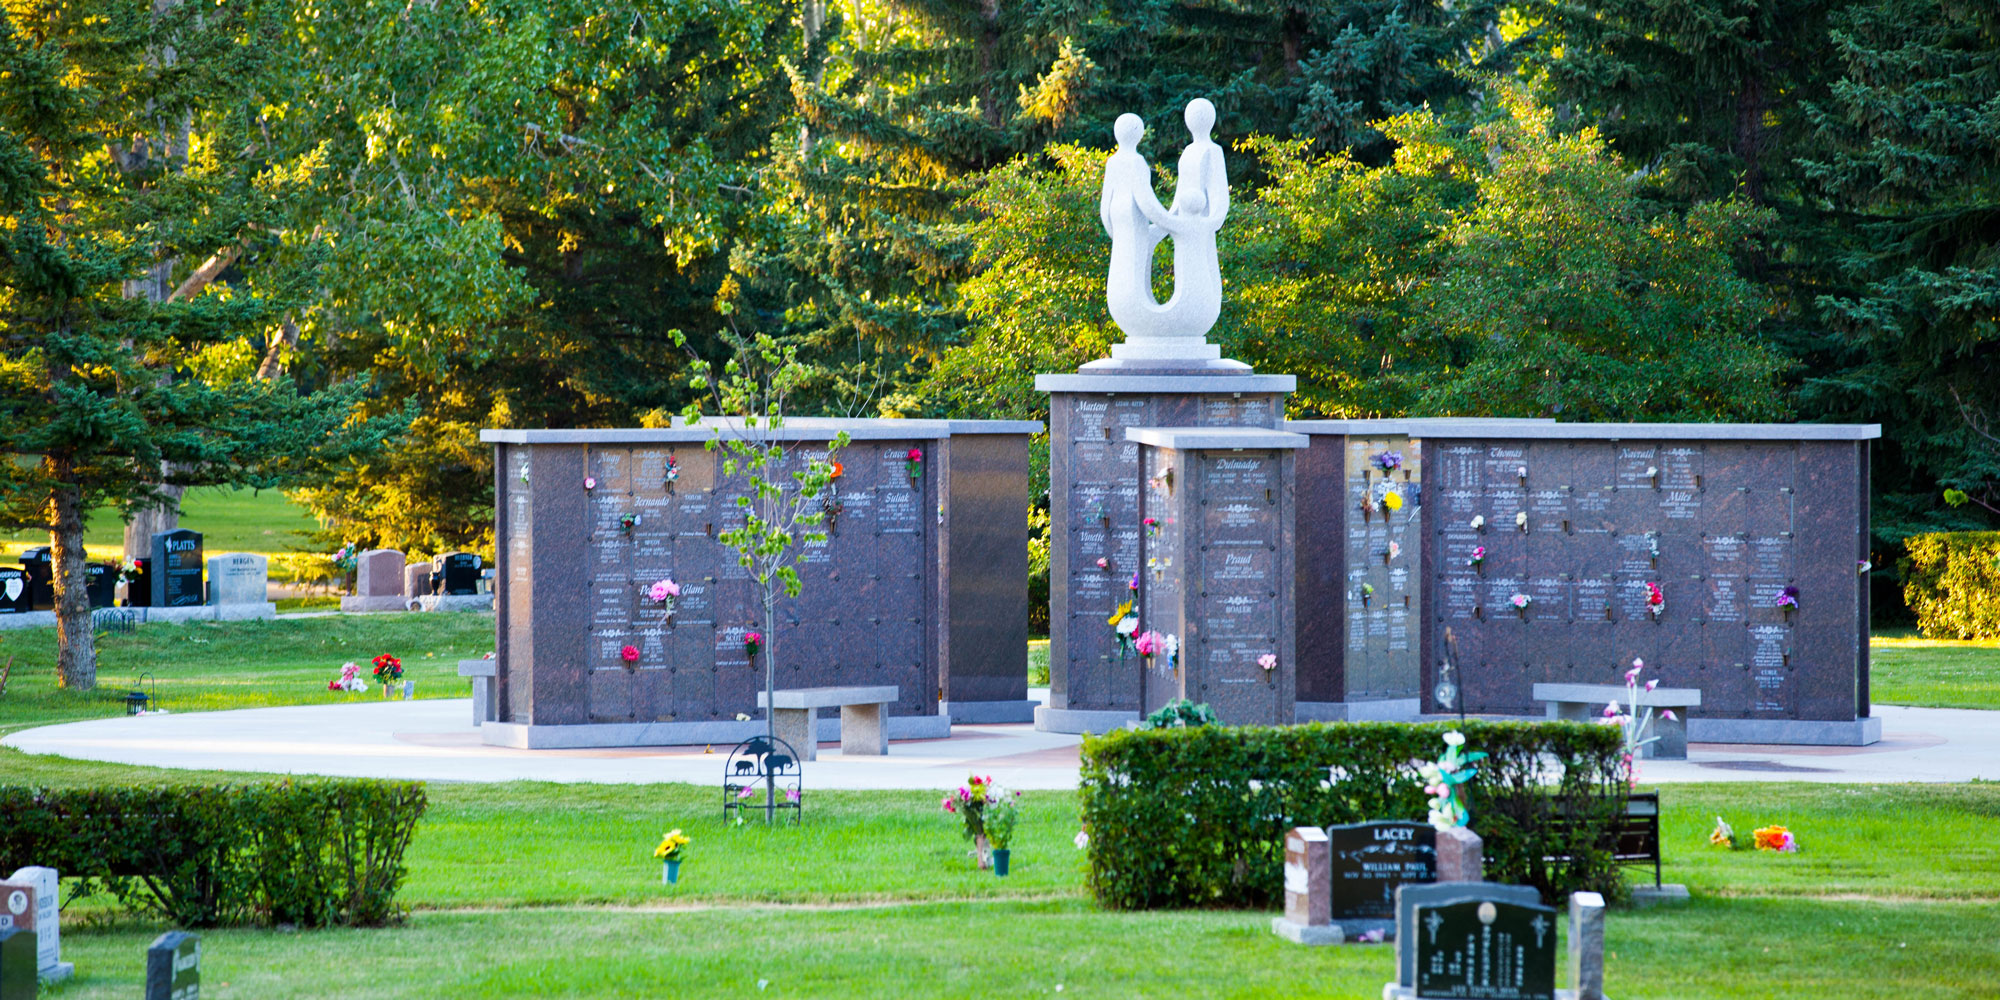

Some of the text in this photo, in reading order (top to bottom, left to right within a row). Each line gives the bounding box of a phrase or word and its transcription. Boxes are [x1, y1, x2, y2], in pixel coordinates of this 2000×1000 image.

[1075, 400, 1108, 413] Martens
[1489, 447, 1523, 459] Thomas
[172, 539, 195, 551] PLATTS
[1374, 828, 1415, 841] LACEY
[1362, 862, 1427, 872] WILLIAM PAUL
